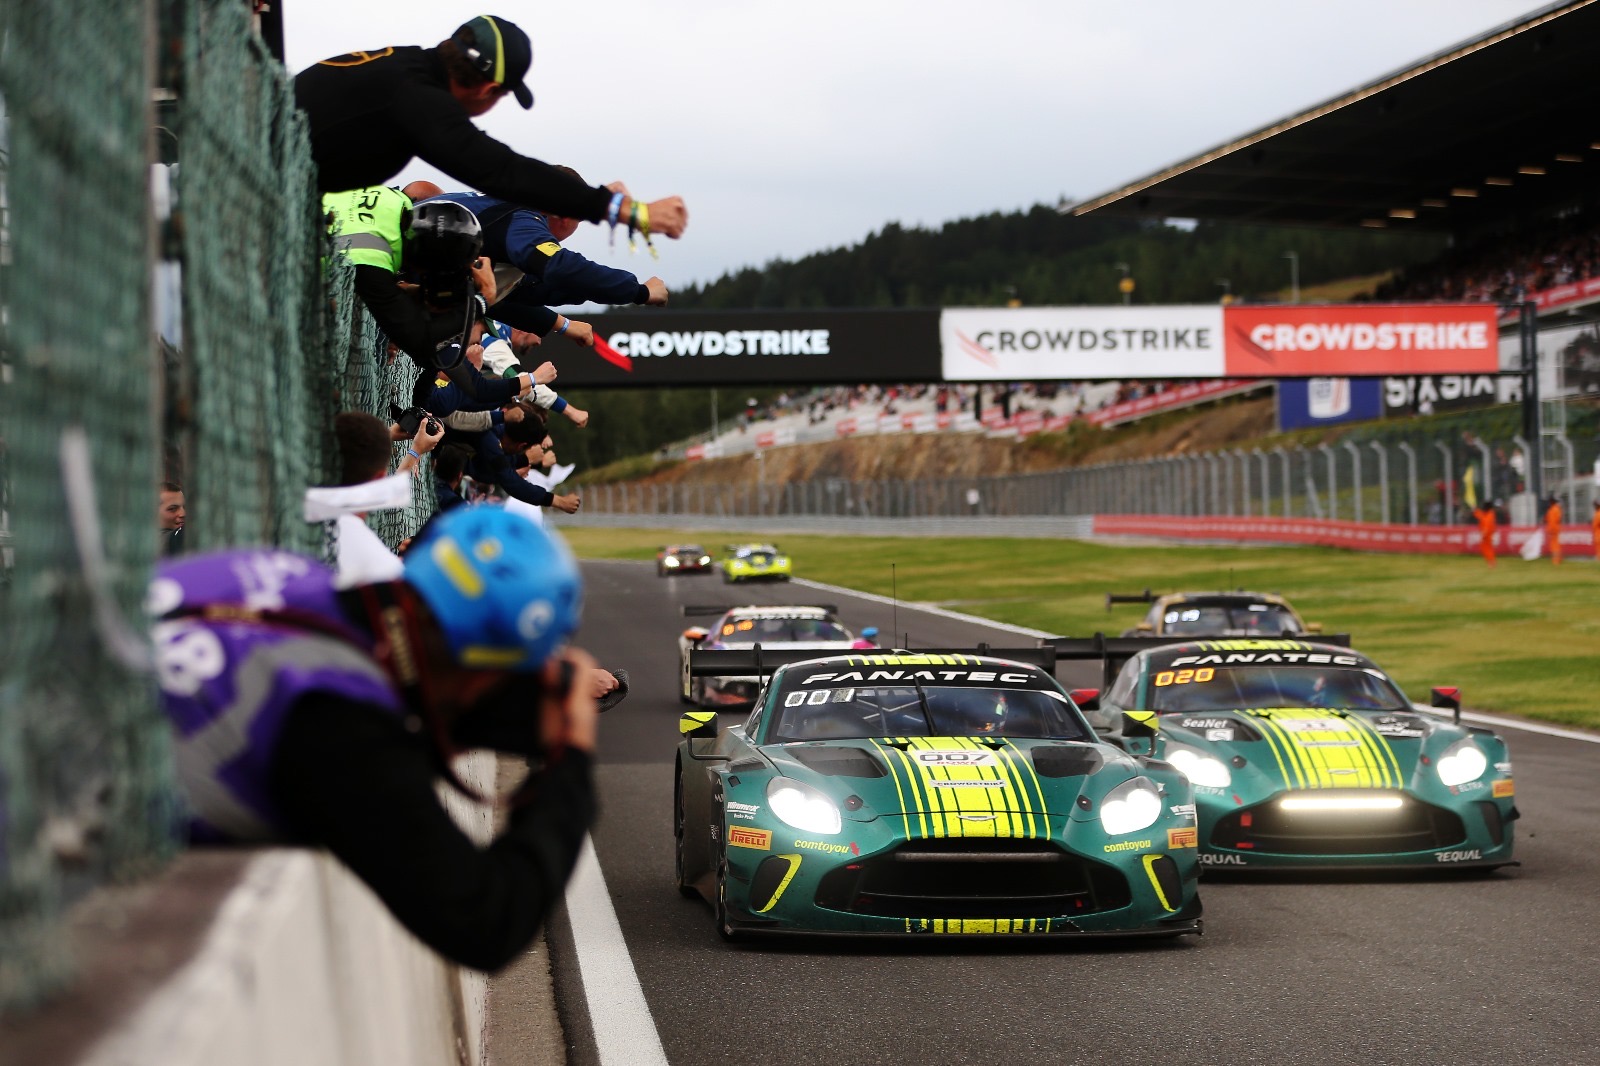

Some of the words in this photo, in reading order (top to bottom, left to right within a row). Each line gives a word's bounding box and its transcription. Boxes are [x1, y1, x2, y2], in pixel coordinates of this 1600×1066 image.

[437, 215, 445, 238] uvex
[608, 329, 830, 357] CROWDSTRIKE
[977, 327, 1211, 352] CROWDSTRIKE
[1250, 322, 1488, 351] CROWDSTRIKE
[1170, 653, 1357, 667] FANATEC
[802, 670, 1031, 685] FANATEC
[1155, 667, 1215, 688] 020
[1182, 718, 1228, 729] SeaNet
[920, 753, 989, 762] 007
[730, 830, 767, 846] PIRELLI
[794, 839, 850, 854] comtoyou
[1103, 839, 1152, 853] comtoyou
